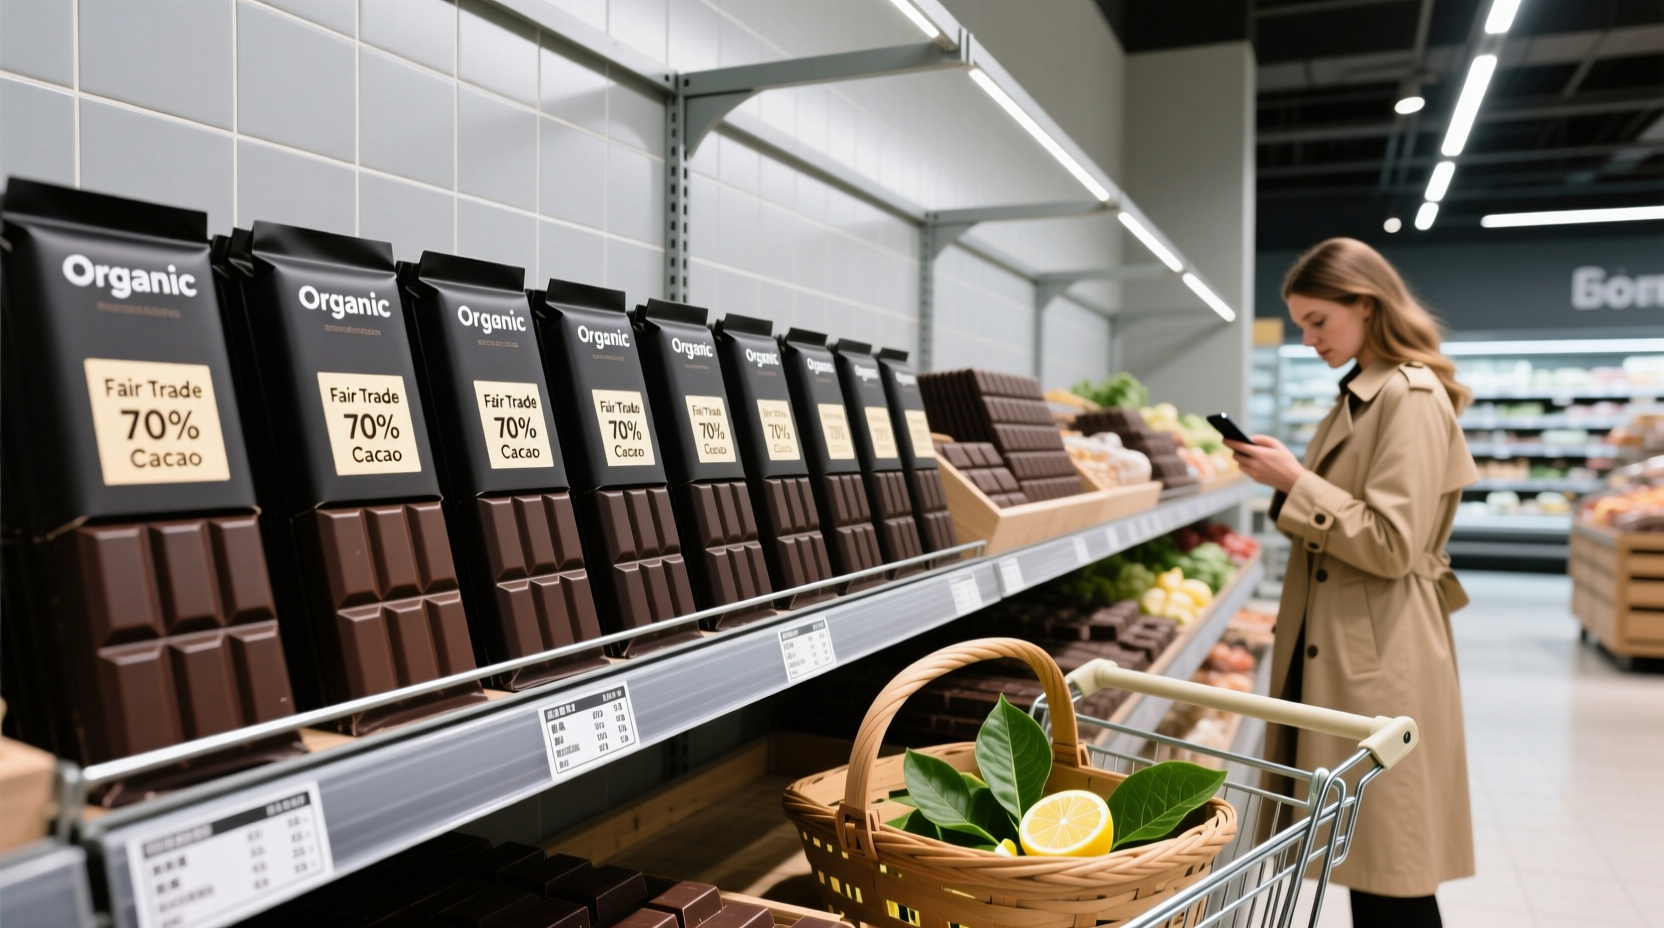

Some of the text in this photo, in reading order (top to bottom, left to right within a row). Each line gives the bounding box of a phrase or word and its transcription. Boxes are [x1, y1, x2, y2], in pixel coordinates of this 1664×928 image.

[62, 254, 198, 299] Organic
[298, 285, 391, 320] Organic
[457, 305, 526, 334] Organic
[578, 325, 630, 349] Organic
[672, 337, 713, 360] Organic
[104, 378, 203, 399] Fair Trade
[330, 387, 399, 405] Fair Trade
[506, 394, 537, 409] Trade
[120, 410, 200, 440] 70%
[344, 413, 400, 440] 70%
[494, 416, 537, 439] 70%
[608, 420, 642, 441] 70%
[698, 422, 725, 440] 70%
[130, 449, 203, 468] Cacao
[352, 446, 402, 464] Cacao
[501, 444, 540, 459] Cacao
